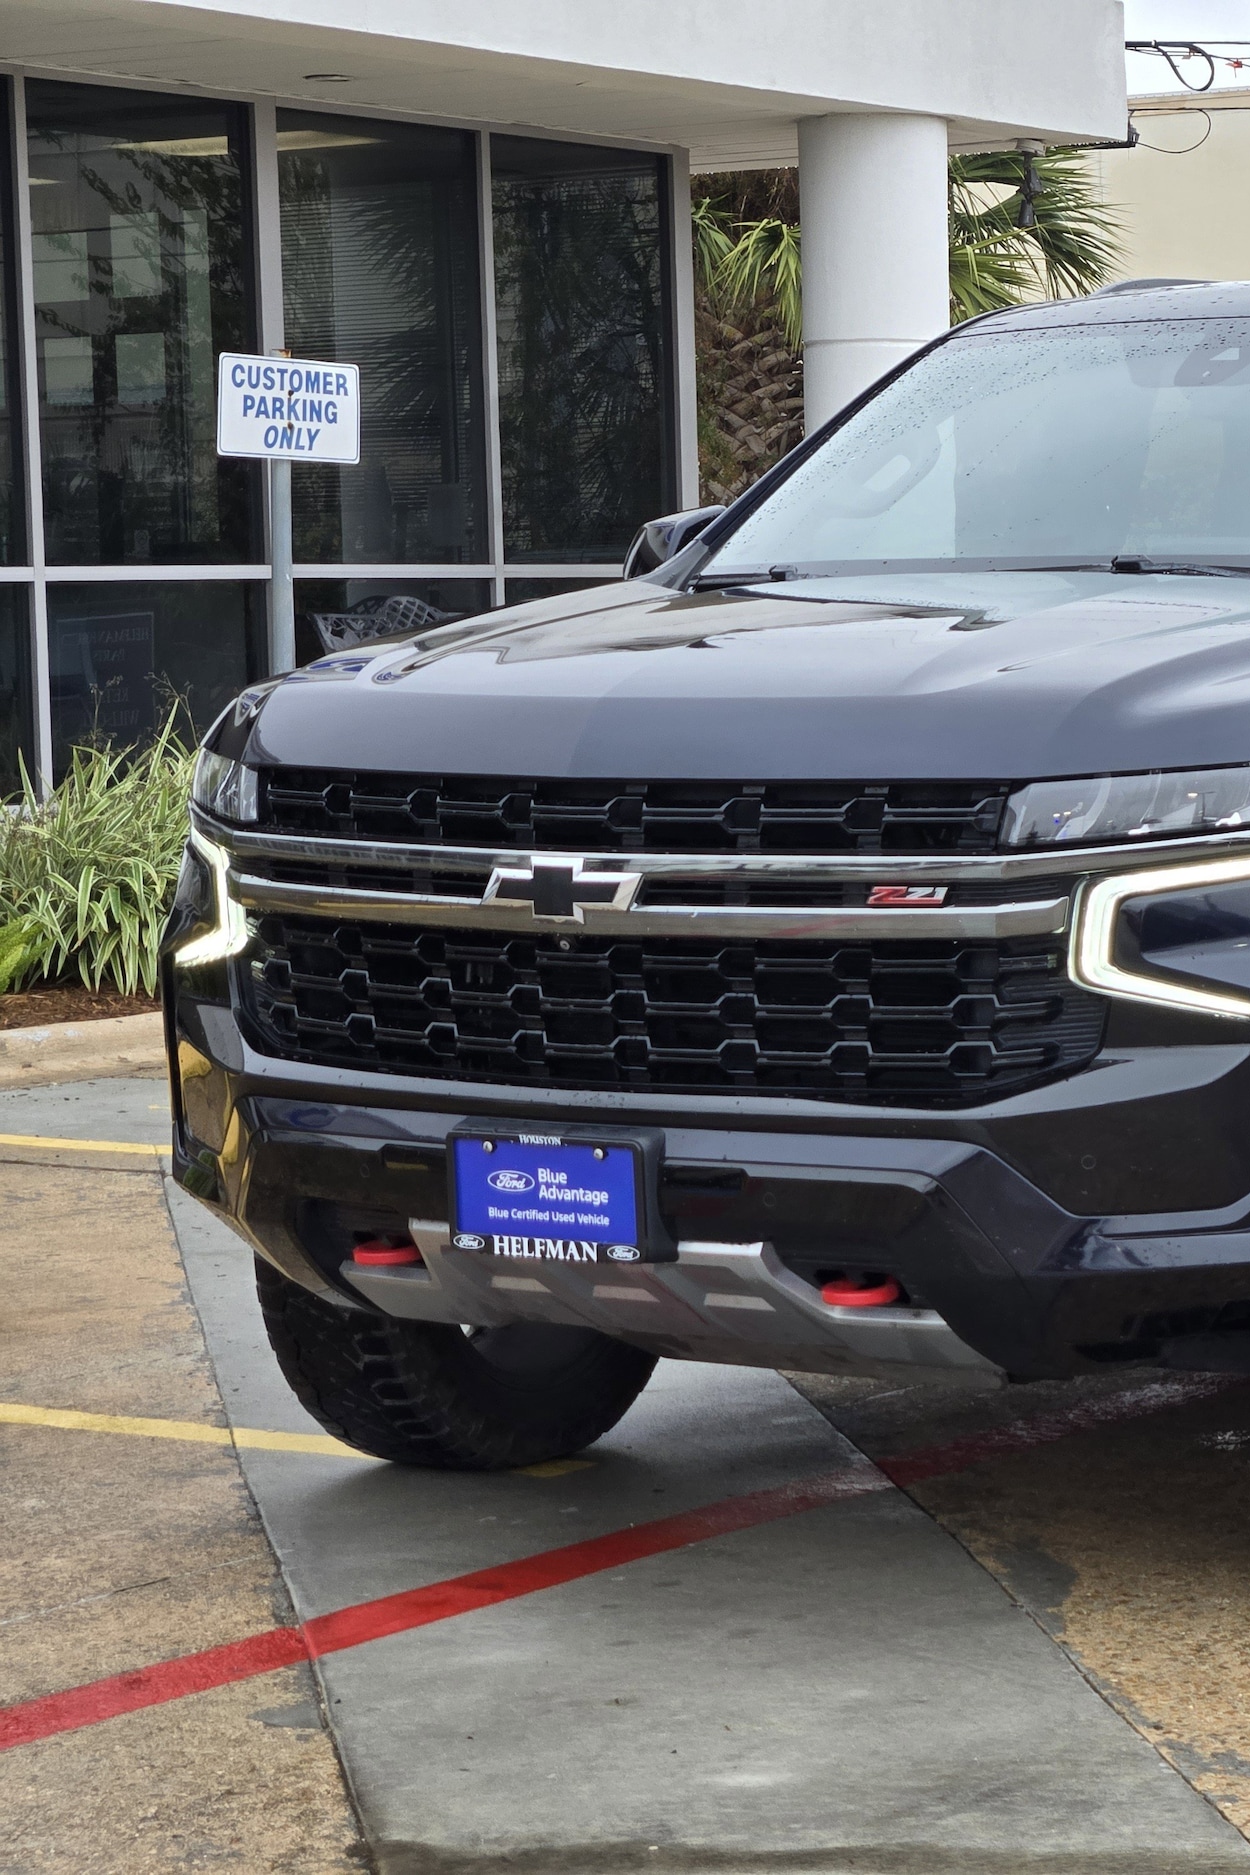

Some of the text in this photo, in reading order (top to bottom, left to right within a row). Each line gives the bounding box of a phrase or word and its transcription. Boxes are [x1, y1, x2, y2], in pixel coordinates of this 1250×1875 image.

[231, 363, 349, 396] CUSTOMER
[242, 394, 338, 424] PARKING
[263, 425, 321, 451] ONLY
[866, 886, 949, 904] Z71
[518, 1134, 562, 1147] HOUSTON
[537, 1167, 568, 1184] Blue
[538, 1185, 609, 1205] Advantage
[488, 1206, 610, 1226] Blue Certified Used Vehicle
[492, 1235, 598, 1263] HELFMAN
